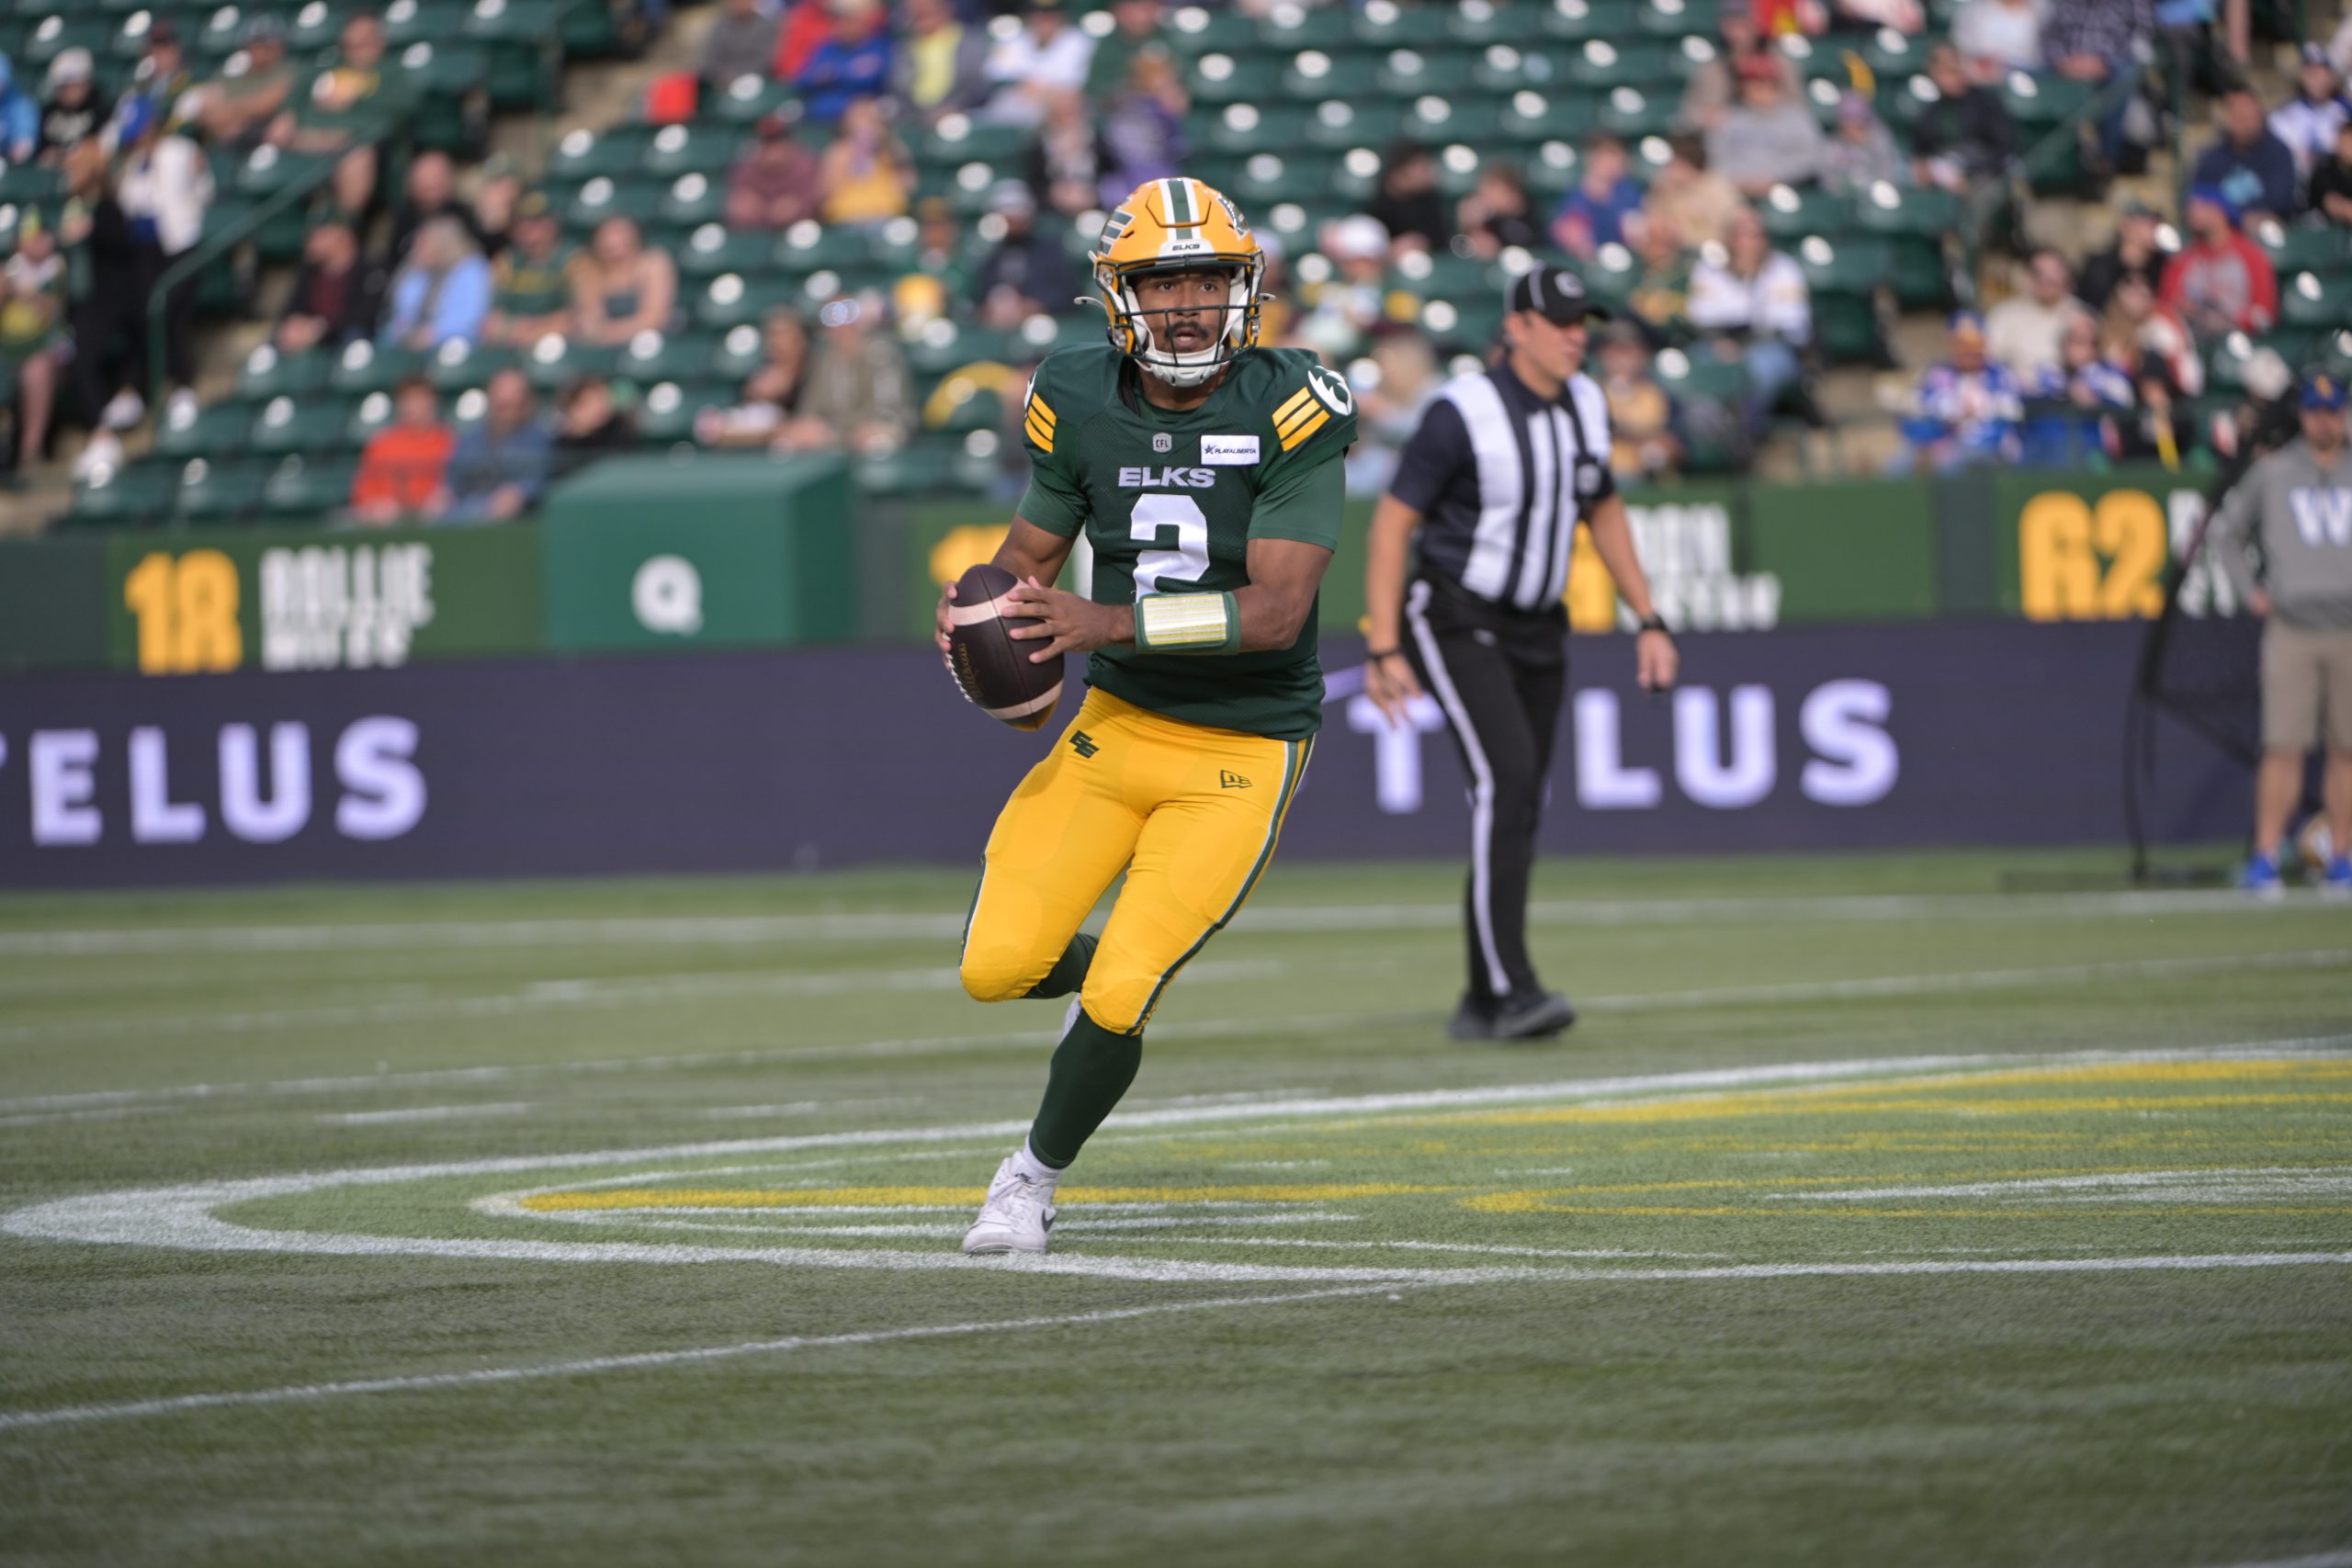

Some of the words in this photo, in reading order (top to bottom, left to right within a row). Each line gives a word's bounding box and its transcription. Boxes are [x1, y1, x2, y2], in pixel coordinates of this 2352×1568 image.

[1172, 243, 1200, 252] ELKS
[1118, 467, 1216, 488] ELKS
[1156, 439, 1169, 448] CFL
[1130, 493, 1210, 604] 2
[630, 553, 705, 638] Q
[0, 715, 427, 847] ELUS
[1345, 678, 1899, 815] TLUS
